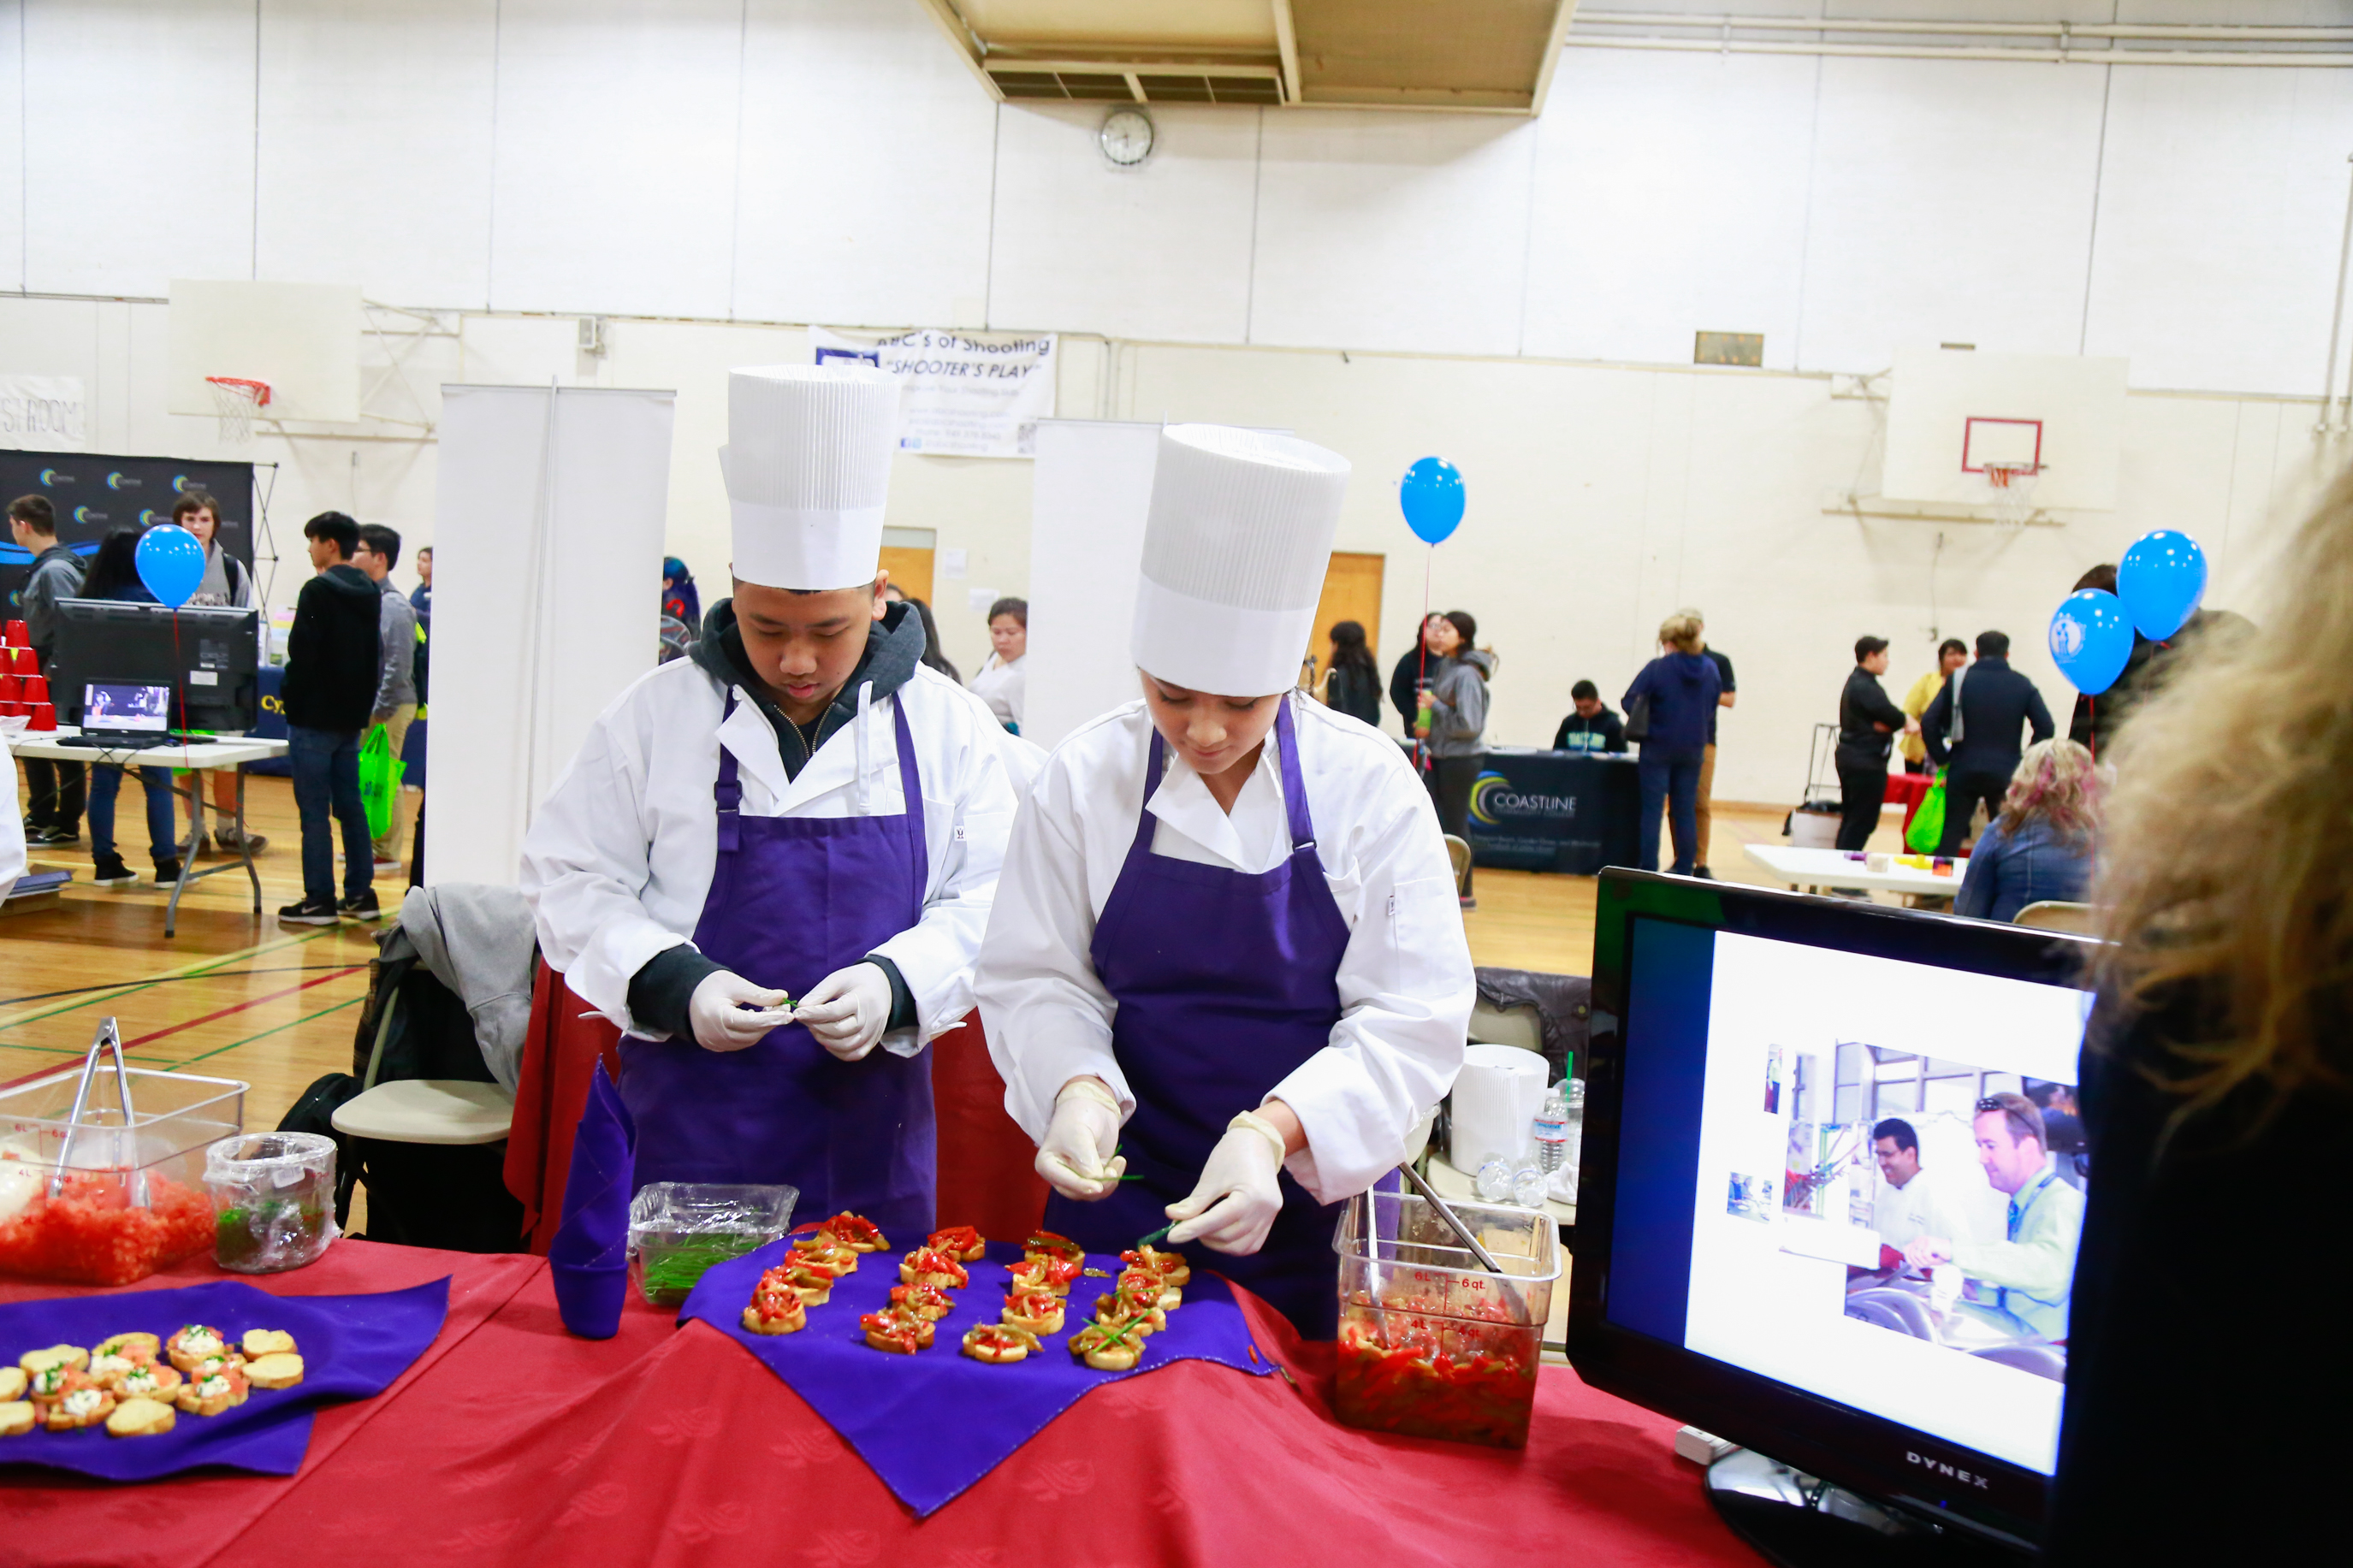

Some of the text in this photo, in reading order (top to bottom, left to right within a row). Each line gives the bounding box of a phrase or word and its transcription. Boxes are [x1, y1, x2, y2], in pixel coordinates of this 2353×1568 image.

[939, 335, 957, 348] of
[963, 337, 1051, 356] Shooting
[1494, 792, 1577, 811] COASTLINE
[1906, 1450, 1988, 1490] DYNEX
